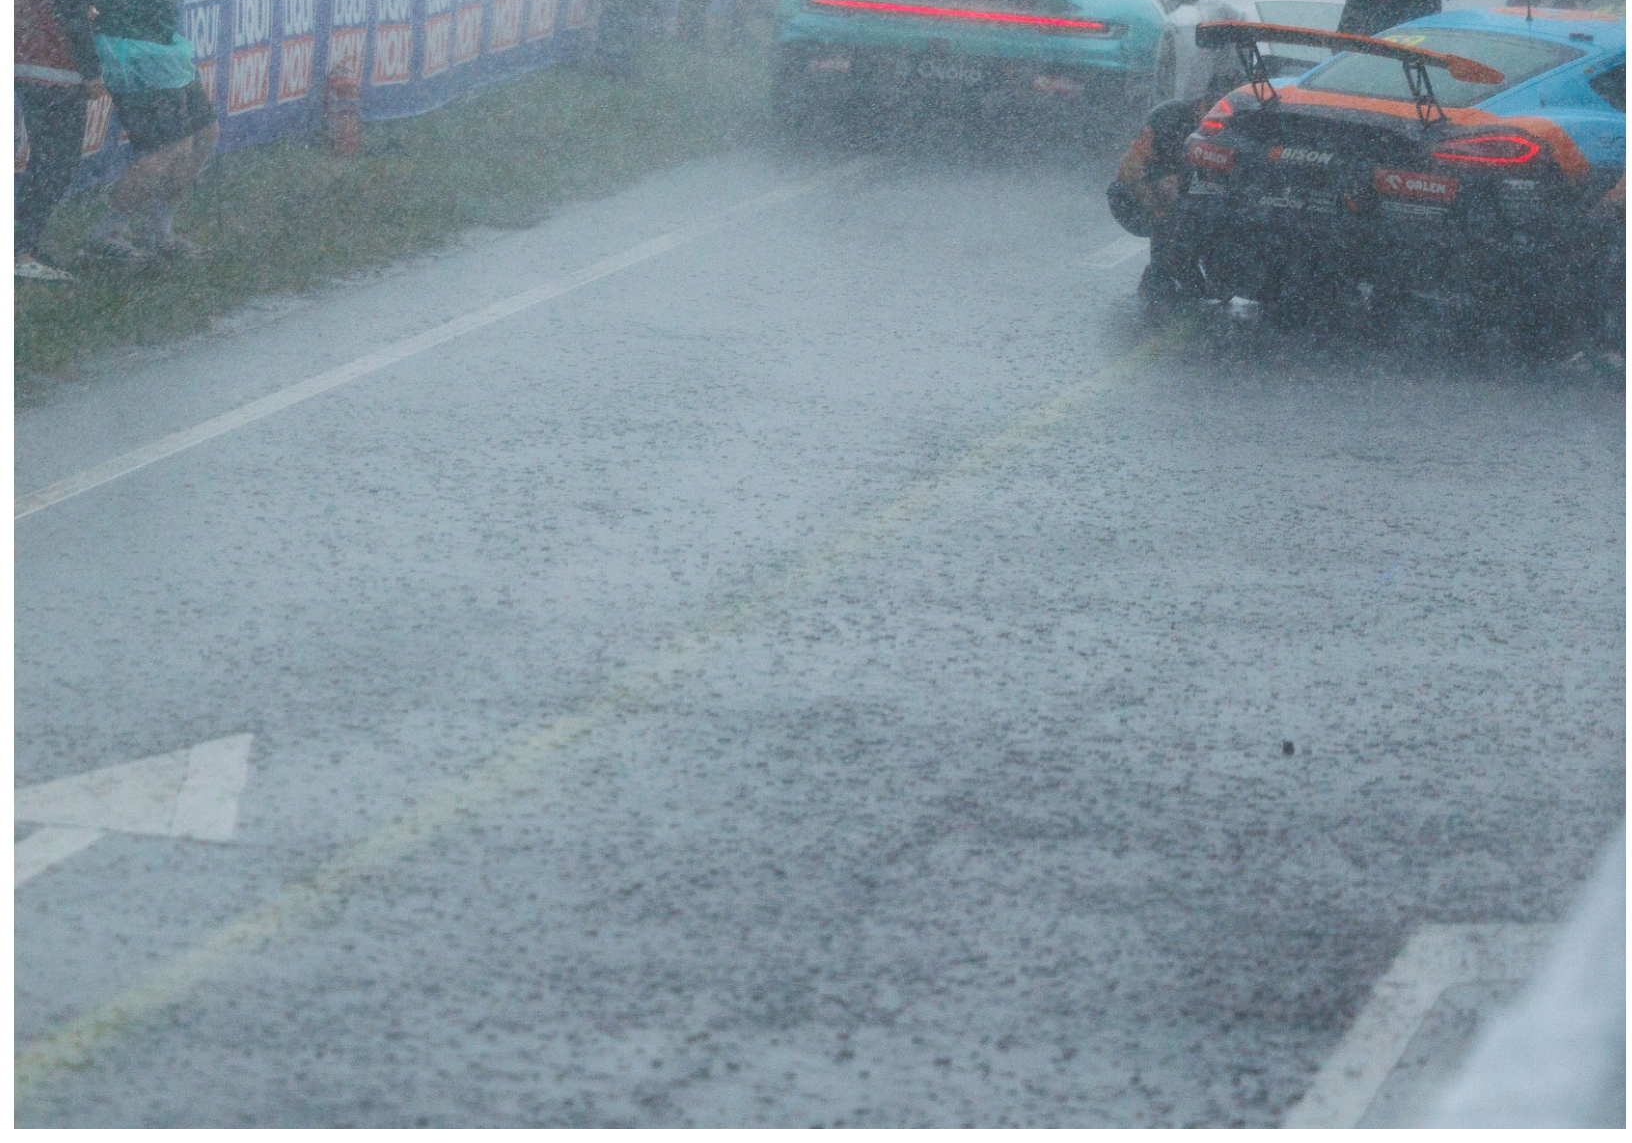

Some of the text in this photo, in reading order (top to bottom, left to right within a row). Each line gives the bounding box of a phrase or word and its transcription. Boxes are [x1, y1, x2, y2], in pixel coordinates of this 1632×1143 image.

[280, 39, 315, 94] MOLY
[375, 29, 411, 77] MOLY
[231, 51, 271, 108] MOLY
[1280, 147, 1334, 165] BISON
